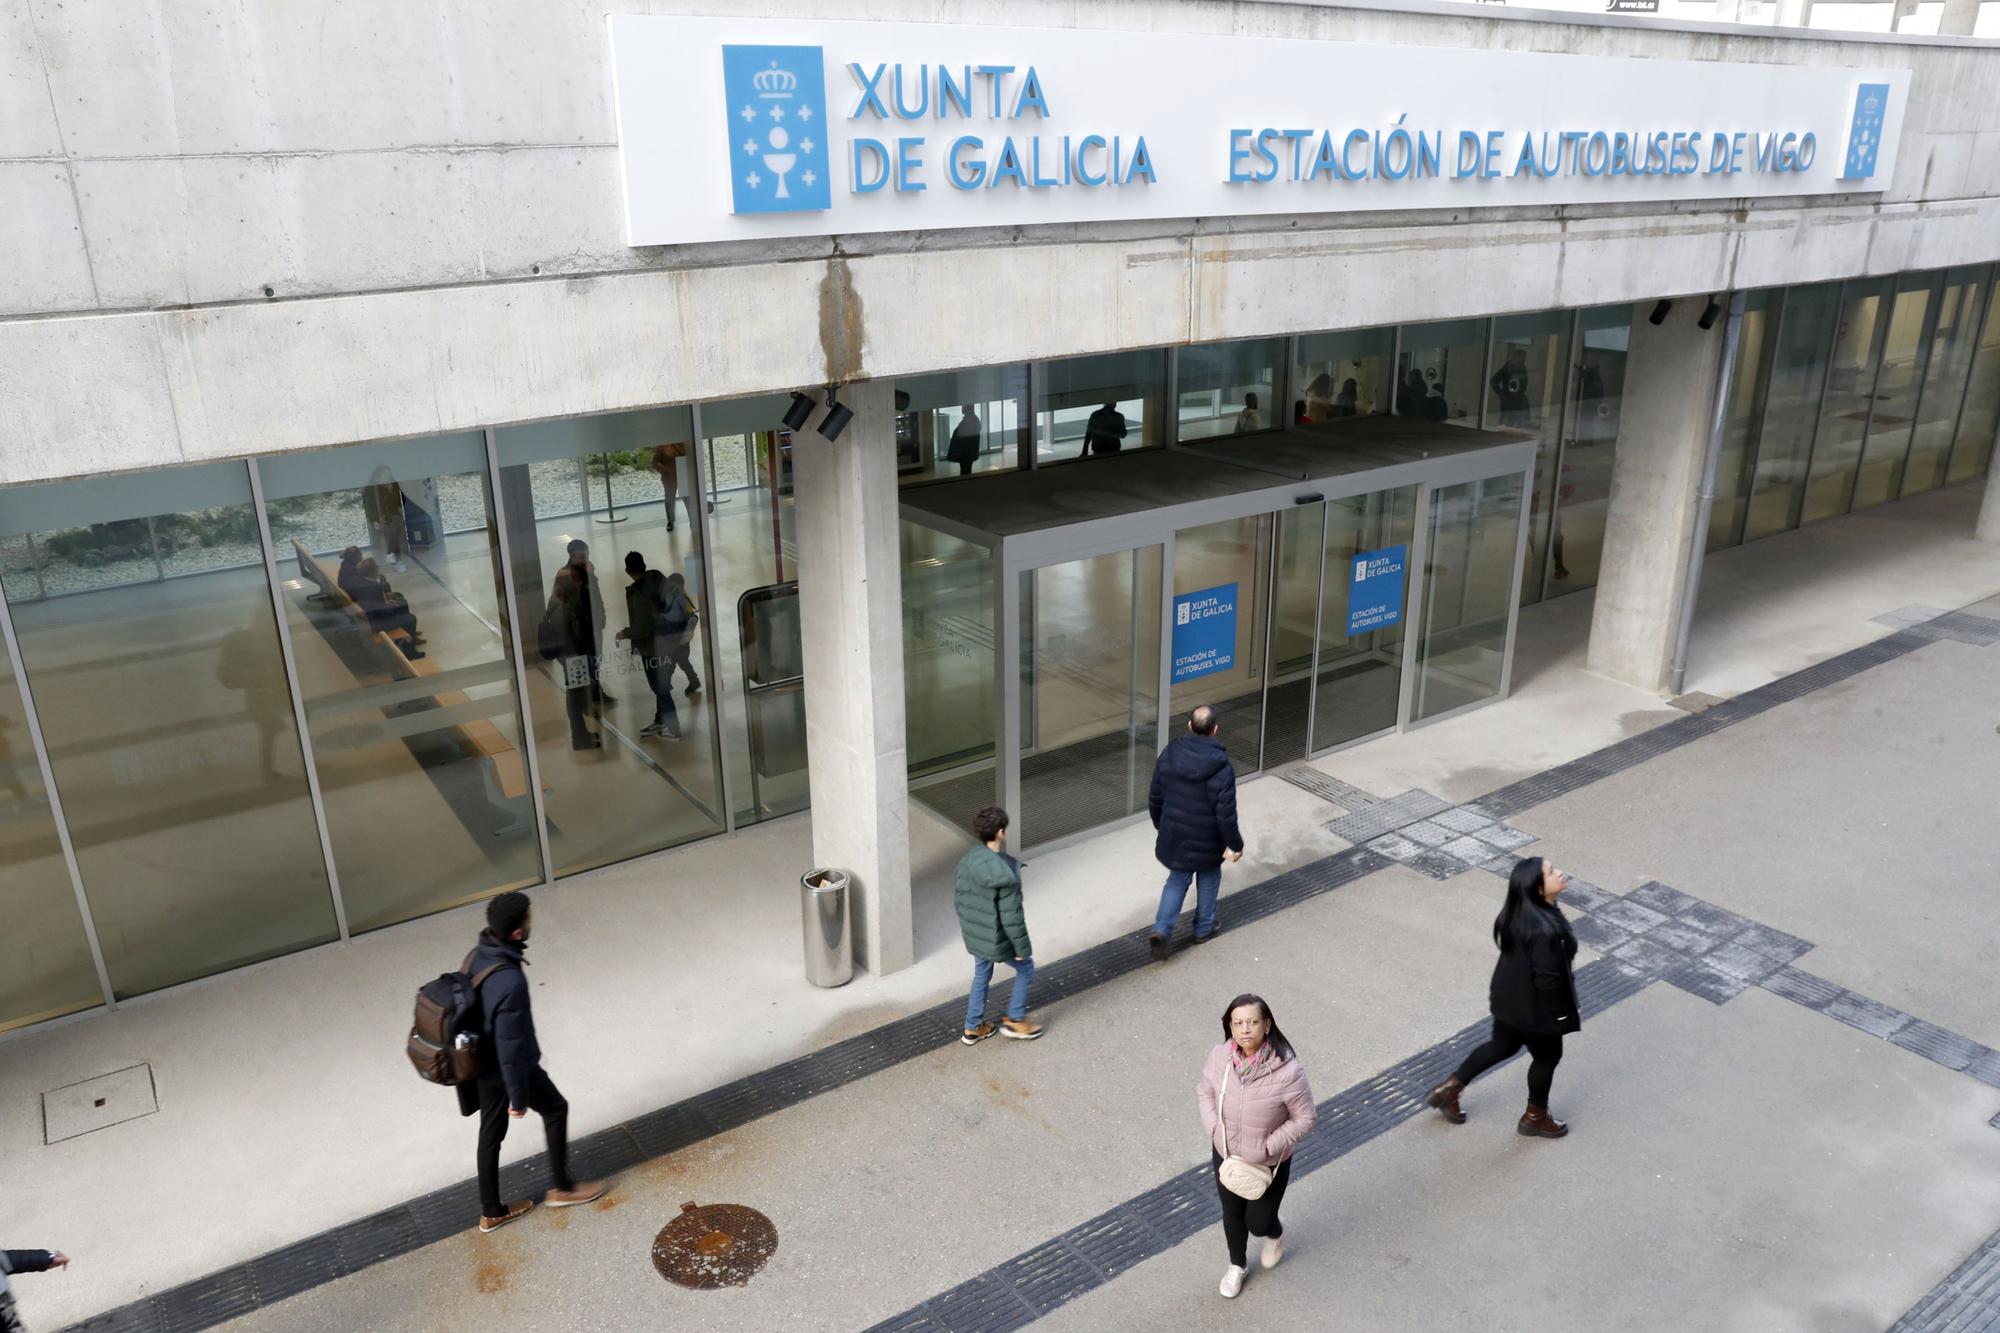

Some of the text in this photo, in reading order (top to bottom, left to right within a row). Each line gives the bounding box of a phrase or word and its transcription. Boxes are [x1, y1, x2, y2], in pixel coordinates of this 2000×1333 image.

[848, 62, 1050, 120] XUNTA
[1226, 113, 1817, 183] ESTACIÓN DE AUTOBUSES DE VIGO
[850, 134, 1157, 193] DE GALICIA
[1367, 563, 1401, 577] DE GALICIA
[1368, 558, 1390, 568] XUNTA
[1191, 603, 1233, 621] DE GALICIA
[1192, 598, 1218, 611] XUNTA
[1379, 605, 1386, 613] DE
[1384, 611, 1397, 620] VIGO
[594, 647, 641, 667] XUNTA
[616, 655, 673, 675] GALICIA
[1176, 649, 1217, 667] ESTACIÓN DE
[1215, 655, 1231, 665] VIGO
